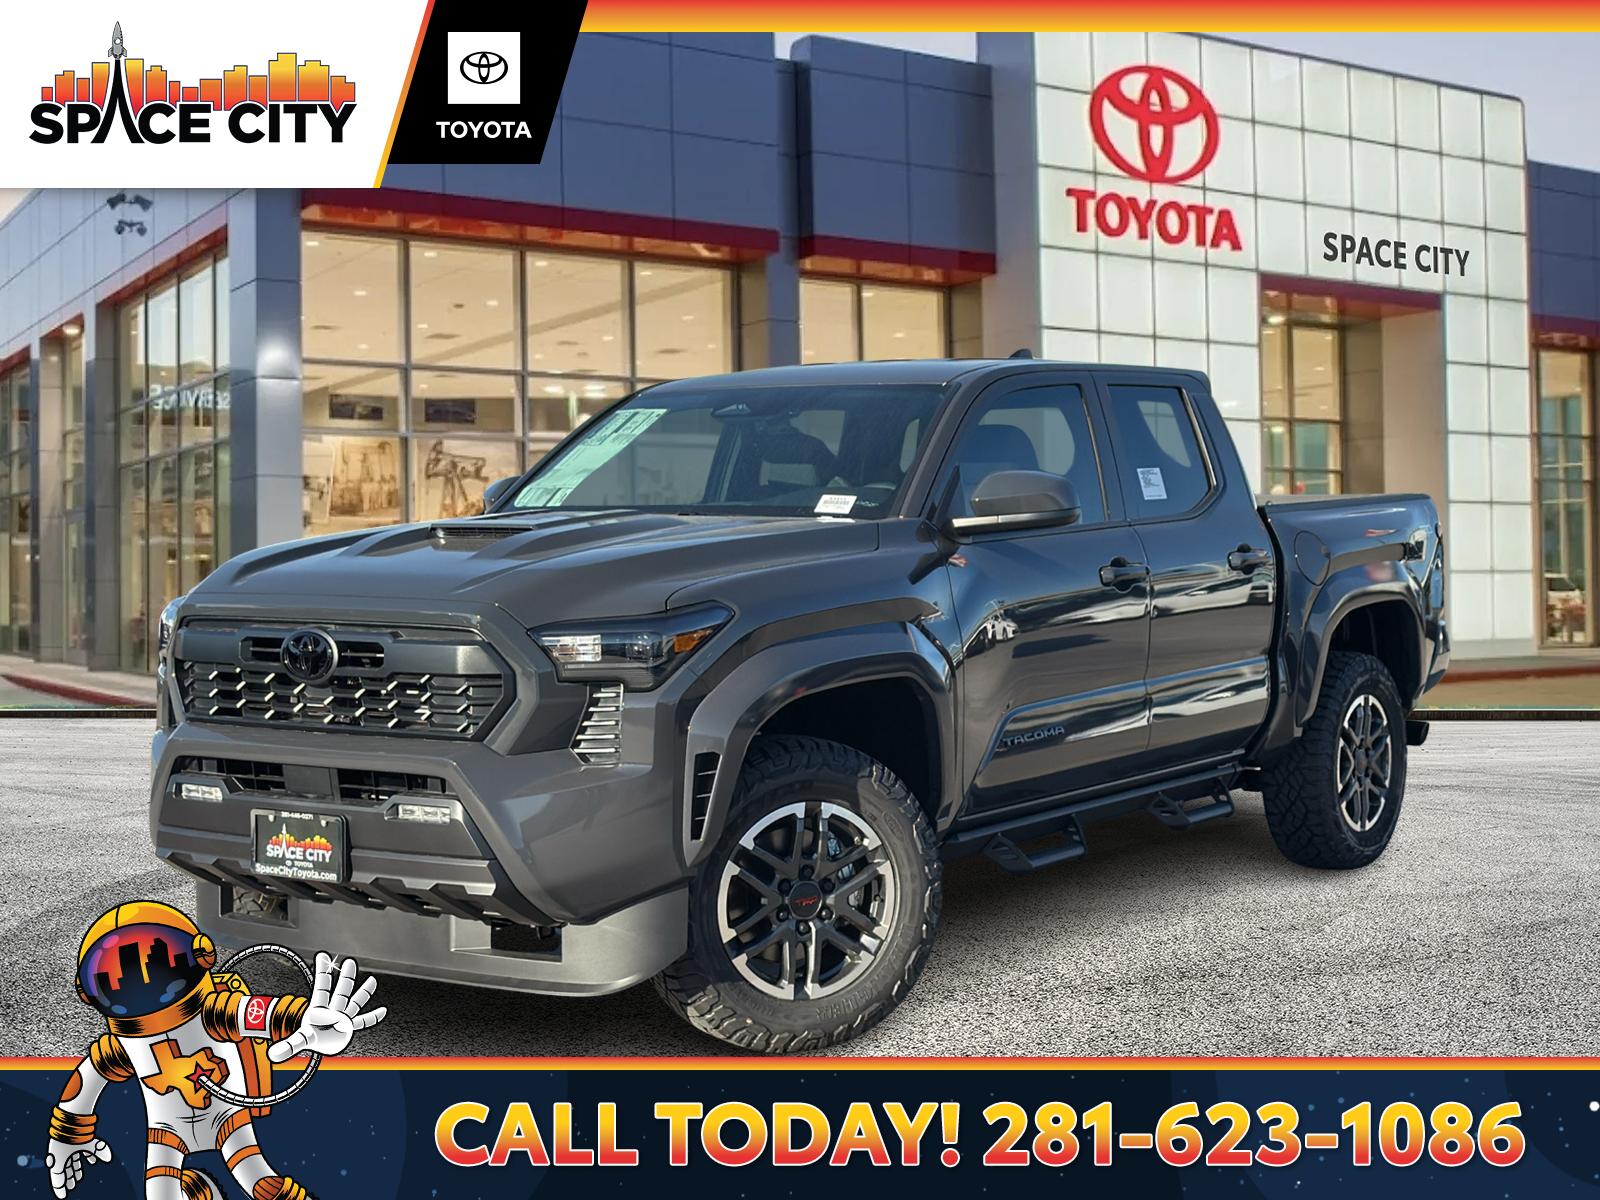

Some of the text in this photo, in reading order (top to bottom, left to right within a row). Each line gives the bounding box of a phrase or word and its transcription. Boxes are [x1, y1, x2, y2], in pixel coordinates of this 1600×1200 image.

[1066, 187, 1243, 251] TOYOTA
[1323, 231, 1471, 277] SPACE CITY
[1002, 726, 1065, 746] TACOMA
[266, 836, 332, 863] SPACE CITY
[255, 863, 337, 881] SpaceCityToyota.com
[294, 860, 313, 868] TOYOTA
